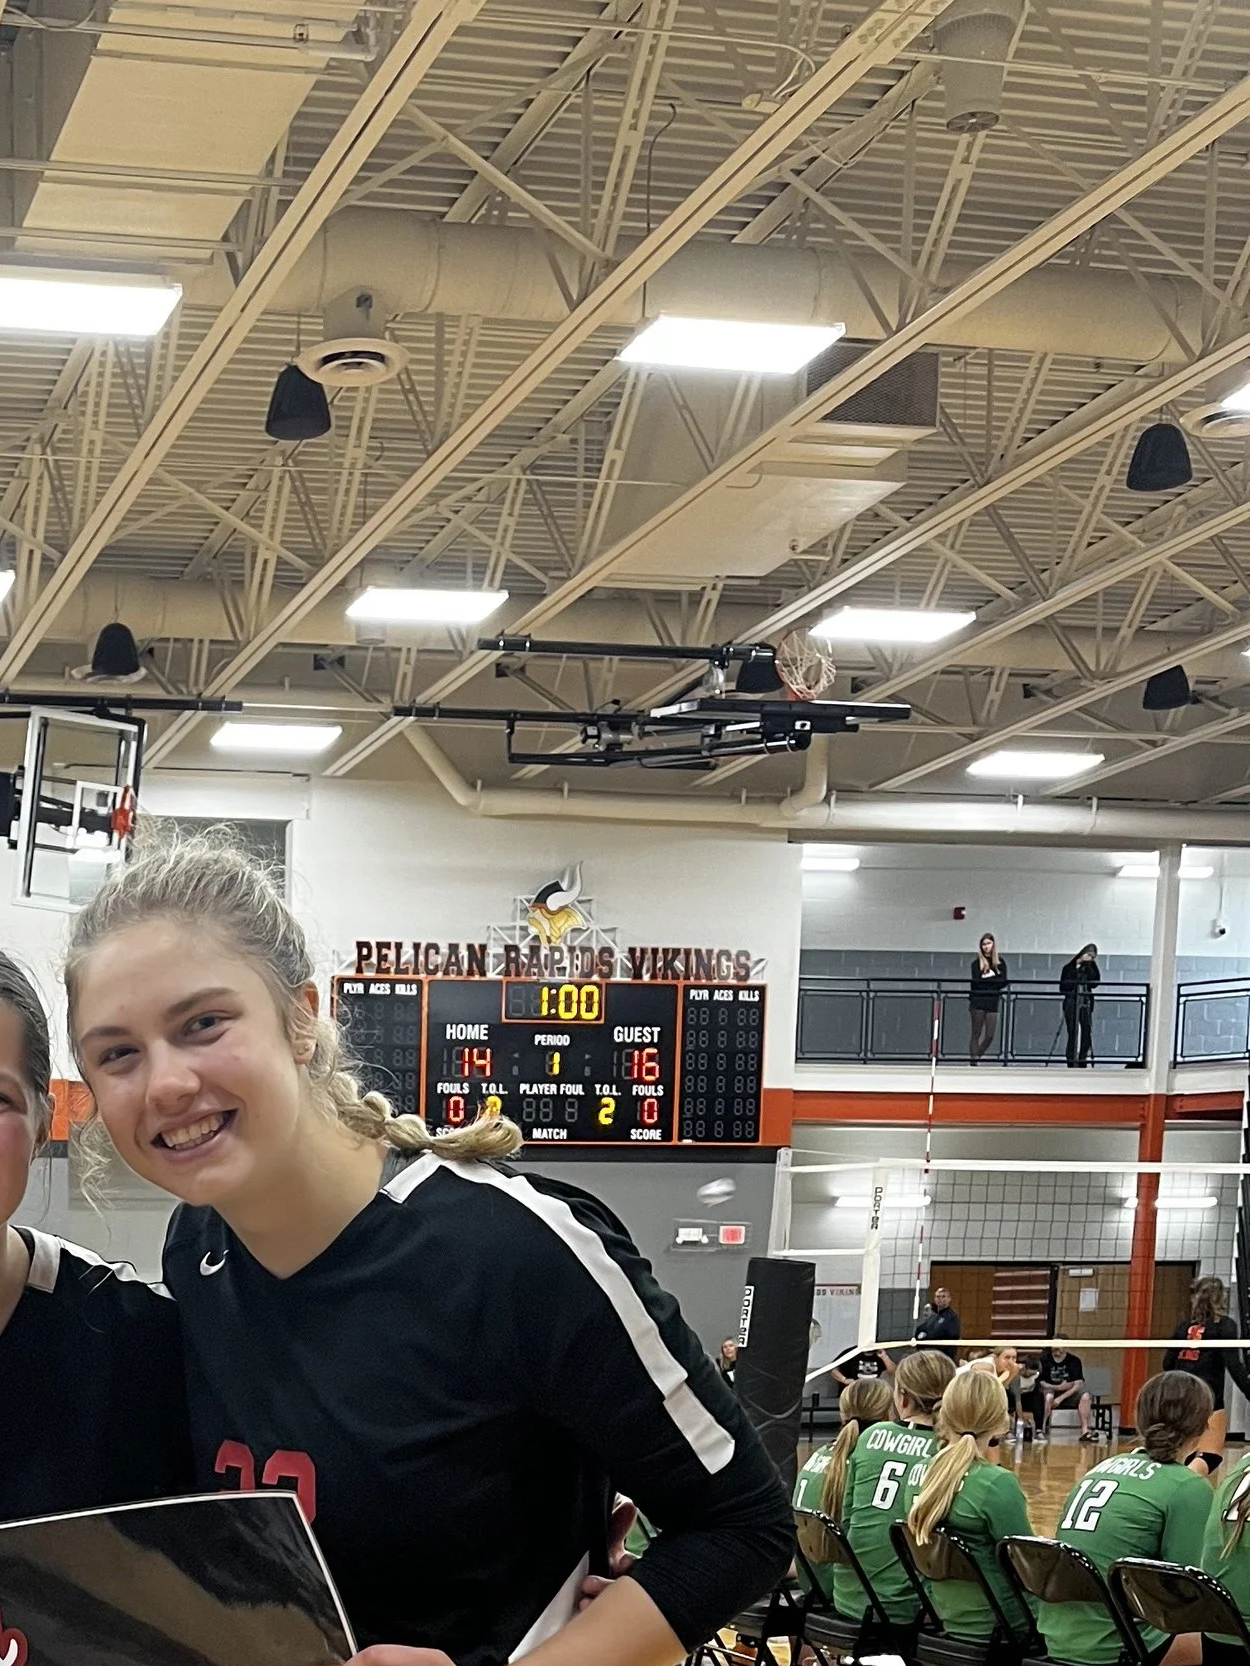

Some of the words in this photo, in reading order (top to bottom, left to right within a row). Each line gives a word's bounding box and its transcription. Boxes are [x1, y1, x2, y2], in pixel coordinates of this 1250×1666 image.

[356, 941, 487, 976] PELICAN
[504, 944, 614, 979] RAPIDS
[628, 947, 751, 981] VIKINGS
[344, 983, 364, 994] PLYR
[369, 983, 391, 995] ACES
[395, 984, 417, 995] KILLS
[690, 989, 709, 1000] PLYR
[713, 990, 733, 1001] ACES
[739, 990, 760, 1001] KILLS
[541, 984, 599, 1020] 1:00
[445, 1024, 489, 1041] HOME
[534, 1035, 570, 1046] PERIOD
[613, 1026, 661, 1043] GUEST
[462, 1048, 493, 1077] 14
[552, 1052, 561, 1075] 1
[631, 1048, 660, 1081] 16
[437, 1083, 470, 1094] FOULS
[481, 1083, 508, 1095] T.O.L.
[520, 1084, 557, 1095] PLAYER
[560, 1084, 585, 1095] FOUL
[594, 1085, 621, 1095] T.O.L.
[632, 1085, 664, 1096] FOULS
[448, 1095, 465, 1123] 0
[598, 1097, 616, 1124] 2
[643, 1098, 659, 1124] 0
[532, 1128, 567, 1139] MATCH
[630, 1129, 662, 1140] SCORE
[866, 1428, 933, 1458] COWGIRL
[871, 1460, 907, 1510] 6
[1061, 1479, 1119, 1532] 12
